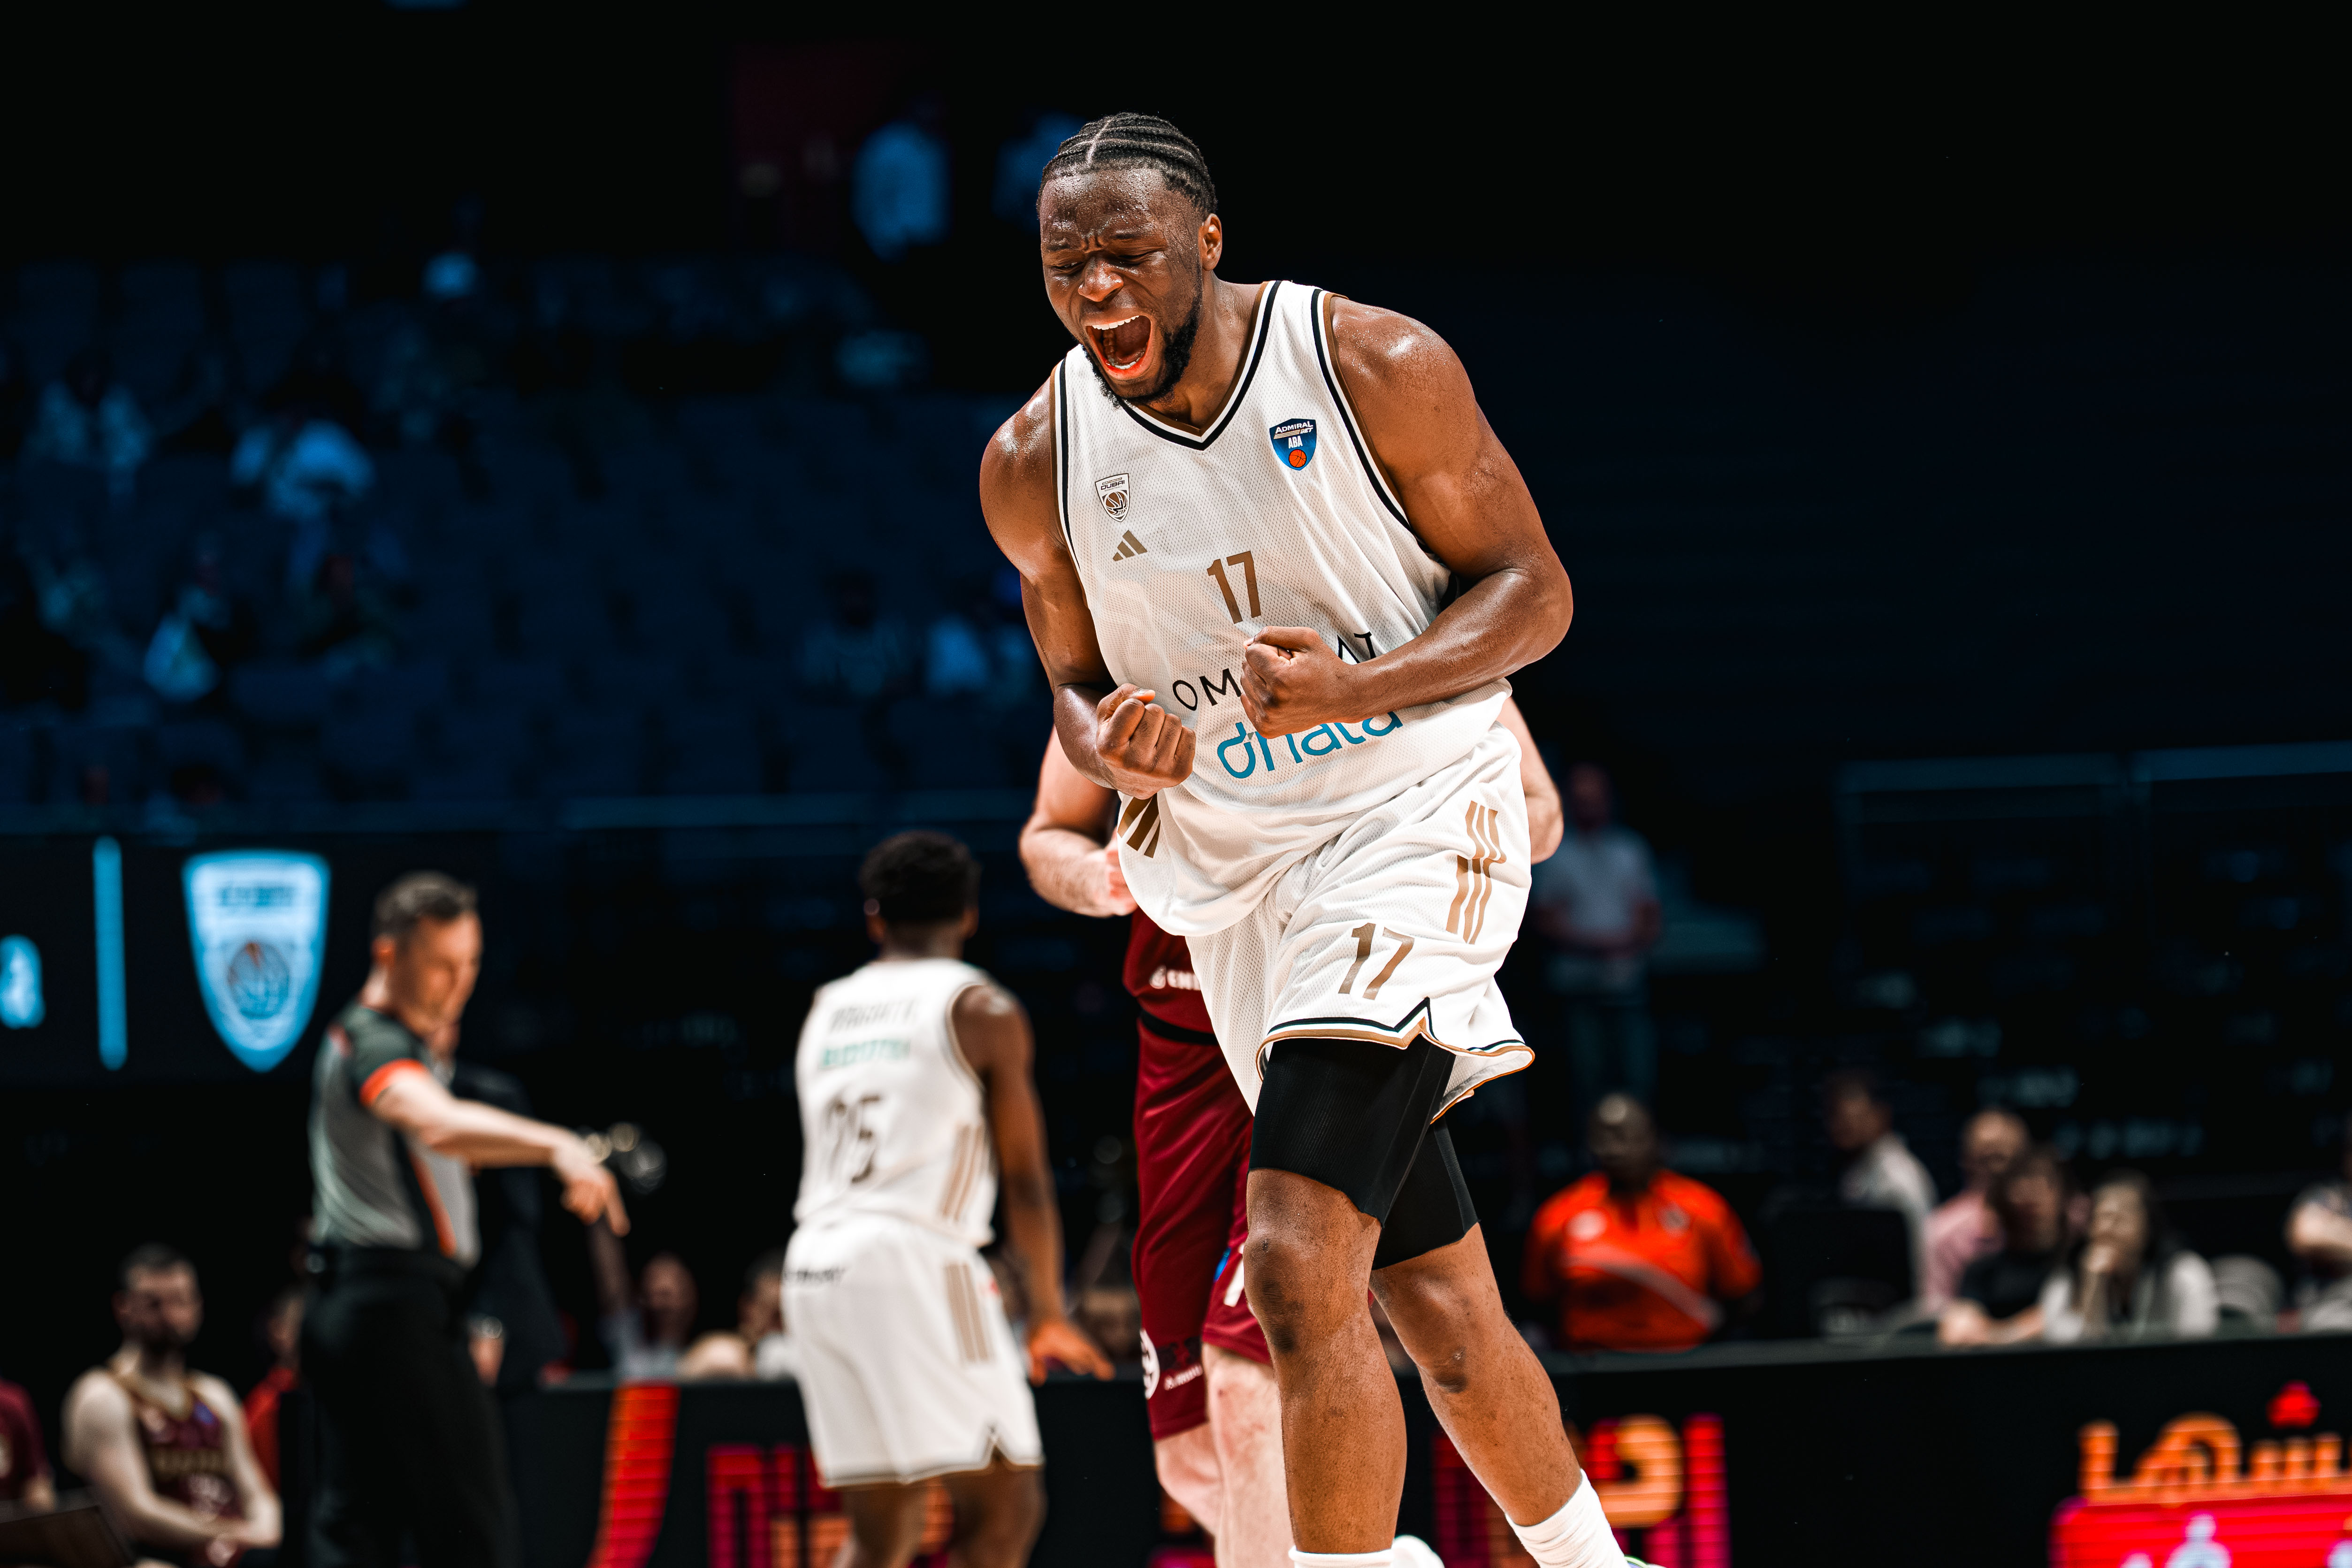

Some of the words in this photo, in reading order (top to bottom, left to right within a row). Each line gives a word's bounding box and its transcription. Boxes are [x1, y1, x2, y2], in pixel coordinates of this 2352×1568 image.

[1275, 421, 1313, 434] ADMIRAL
[1288, 436, 1303, 449] ABA
[1100, 480, 1125, 490] DUBAI
[1207, 550, 1261, 624] 17
[1338, 922, 1415, 1001] 17
